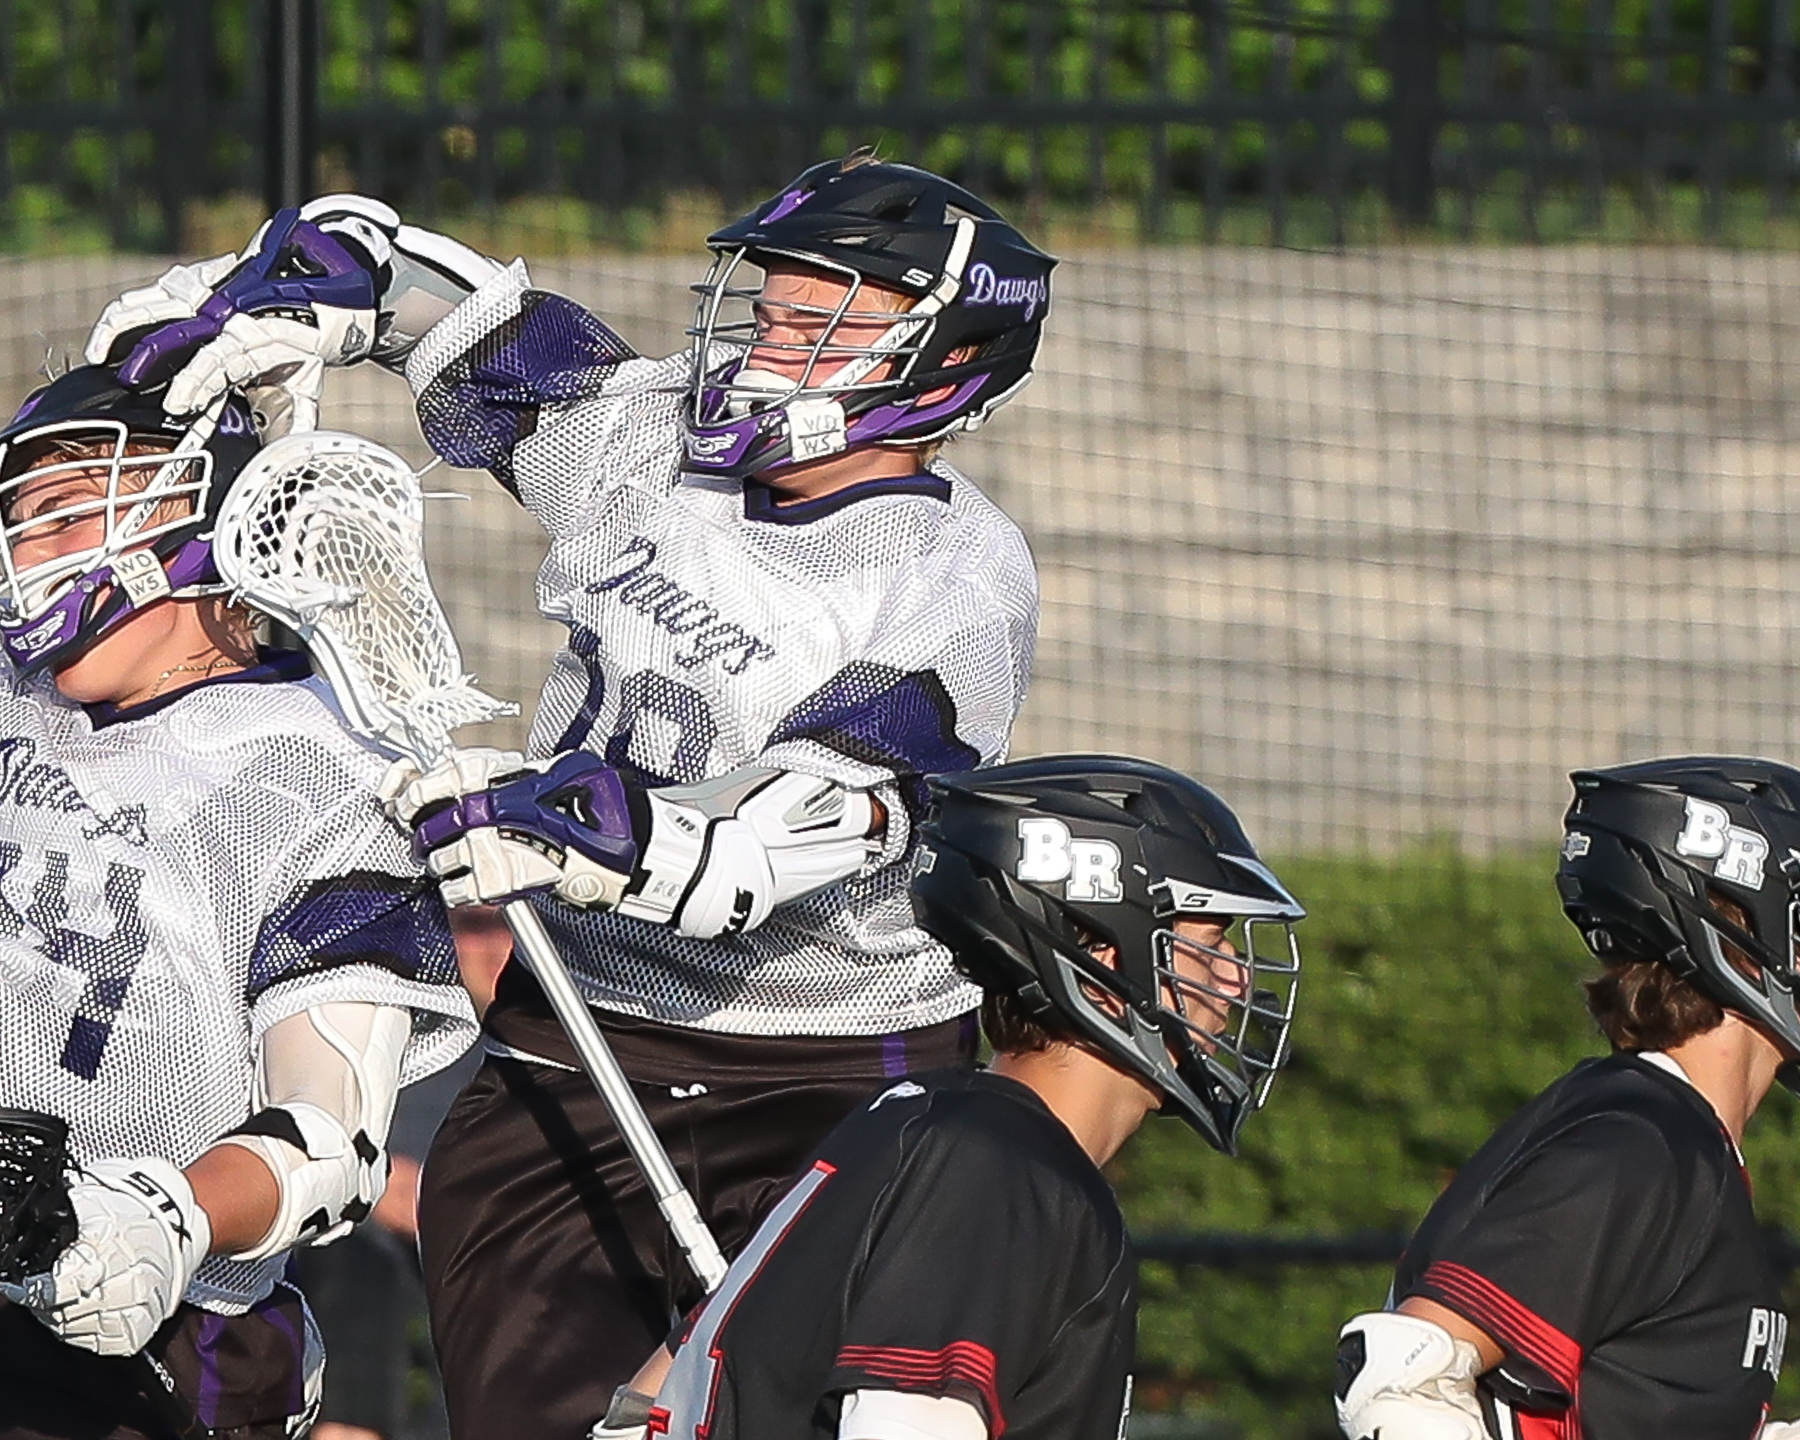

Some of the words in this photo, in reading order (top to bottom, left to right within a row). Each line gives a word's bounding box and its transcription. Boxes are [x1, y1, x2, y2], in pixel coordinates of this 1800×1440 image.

[965, 262, 1047, 323] Dawgs
[1017, 818, 1123, 903] BR
[1676, 795, 1769, 891] BR
[121, 1171, 192, 1253] STX
